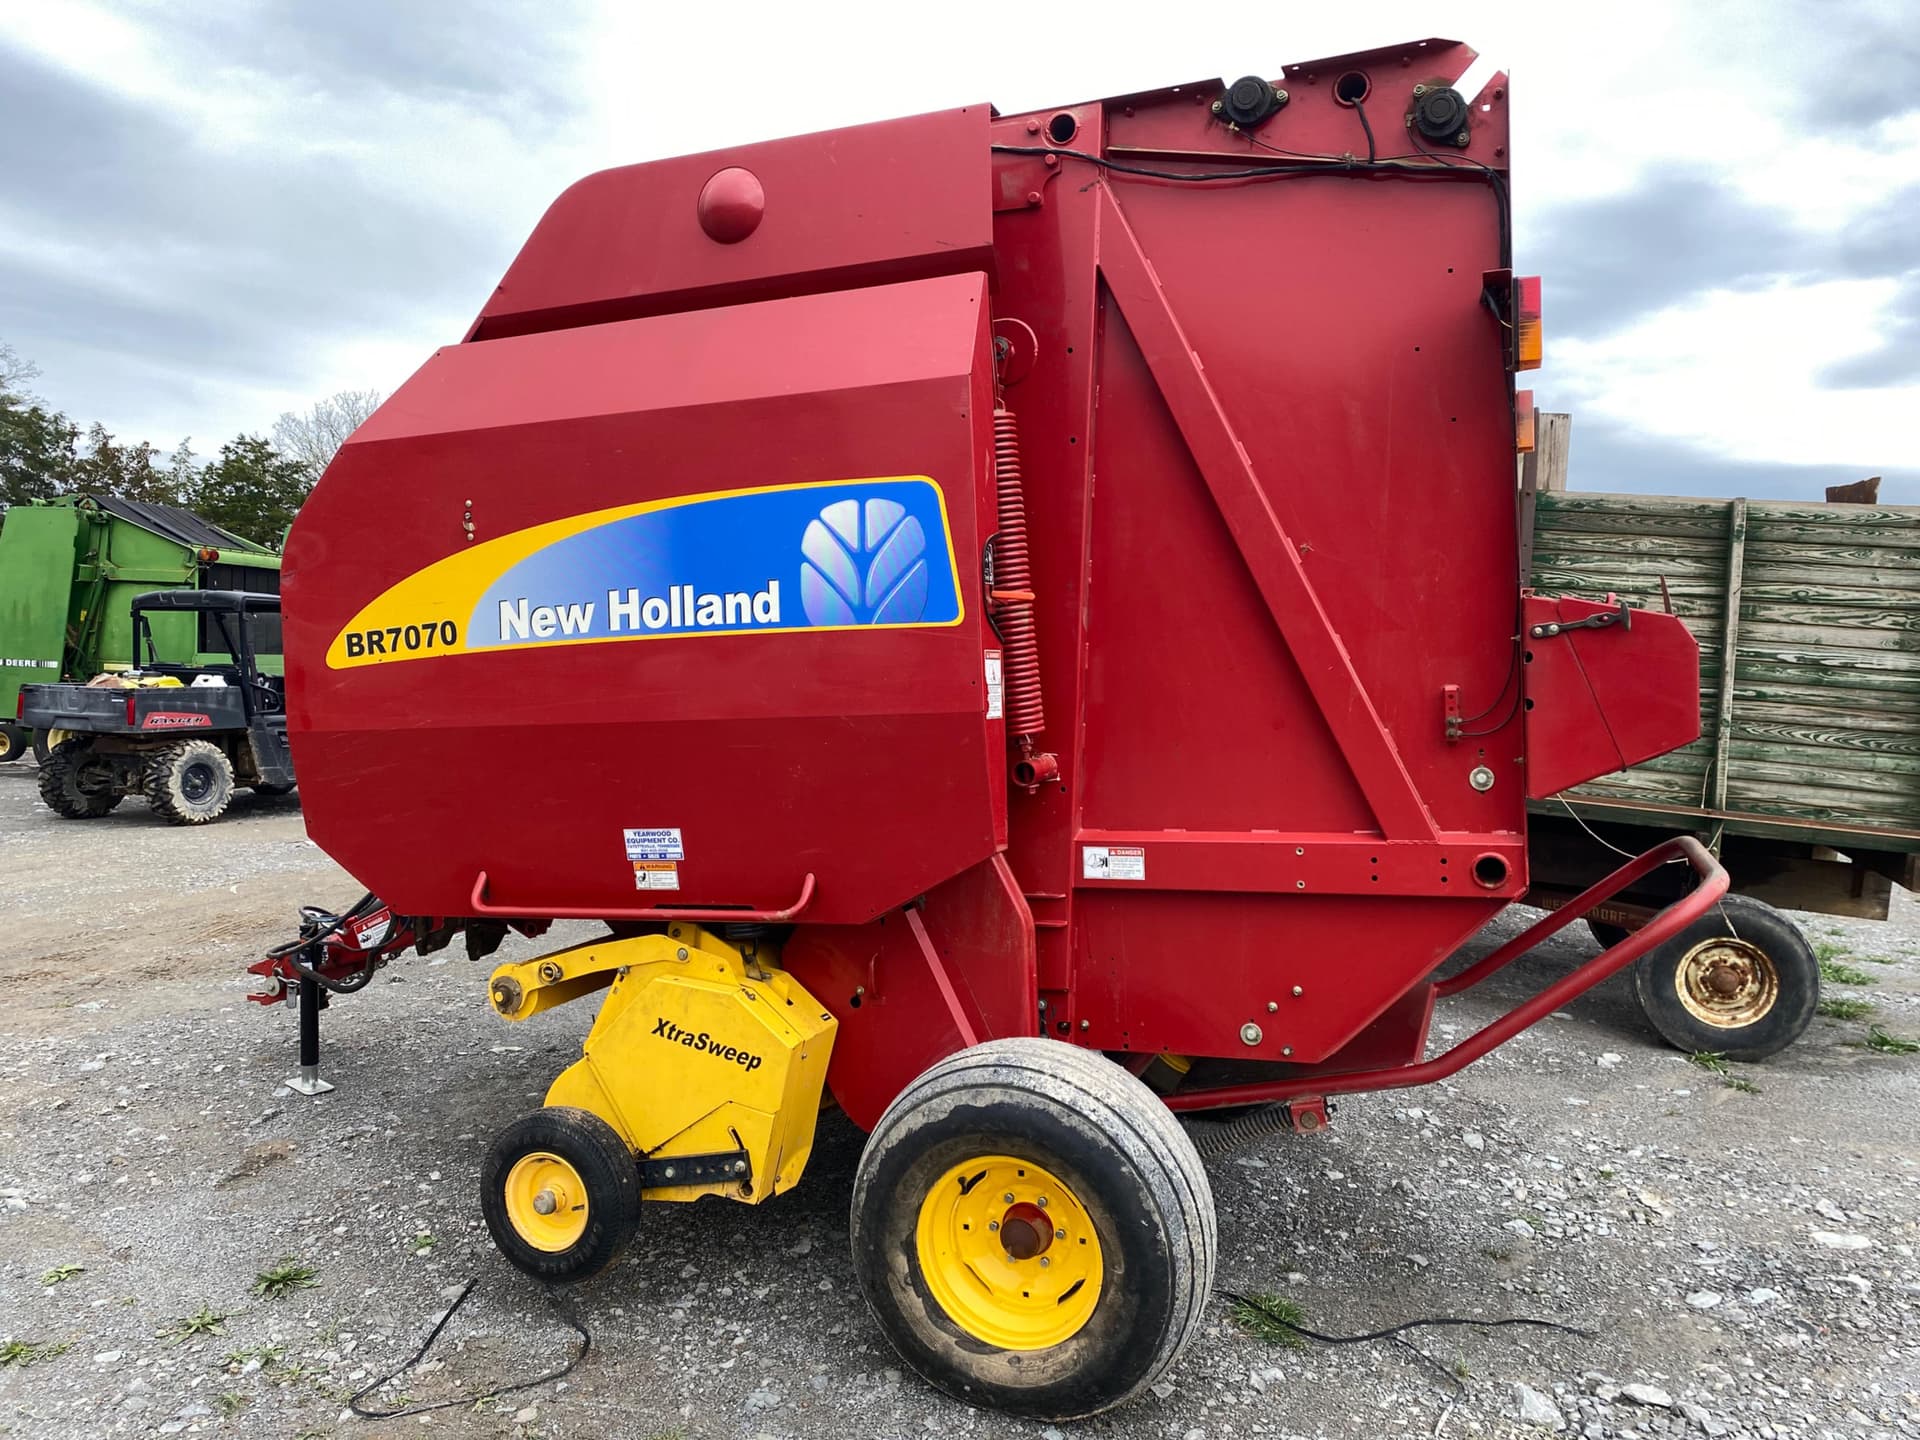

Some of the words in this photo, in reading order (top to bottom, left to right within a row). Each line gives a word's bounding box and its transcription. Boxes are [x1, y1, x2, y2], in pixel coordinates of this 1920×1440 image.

[499, 598, 594, 641] New
[608, 579, 780, 631] Holland
[345, 620, 457, 658] BR7070
[5, 658, 38, 668] DEERE
[651, 1017, 762, 1072] XtraSweep
